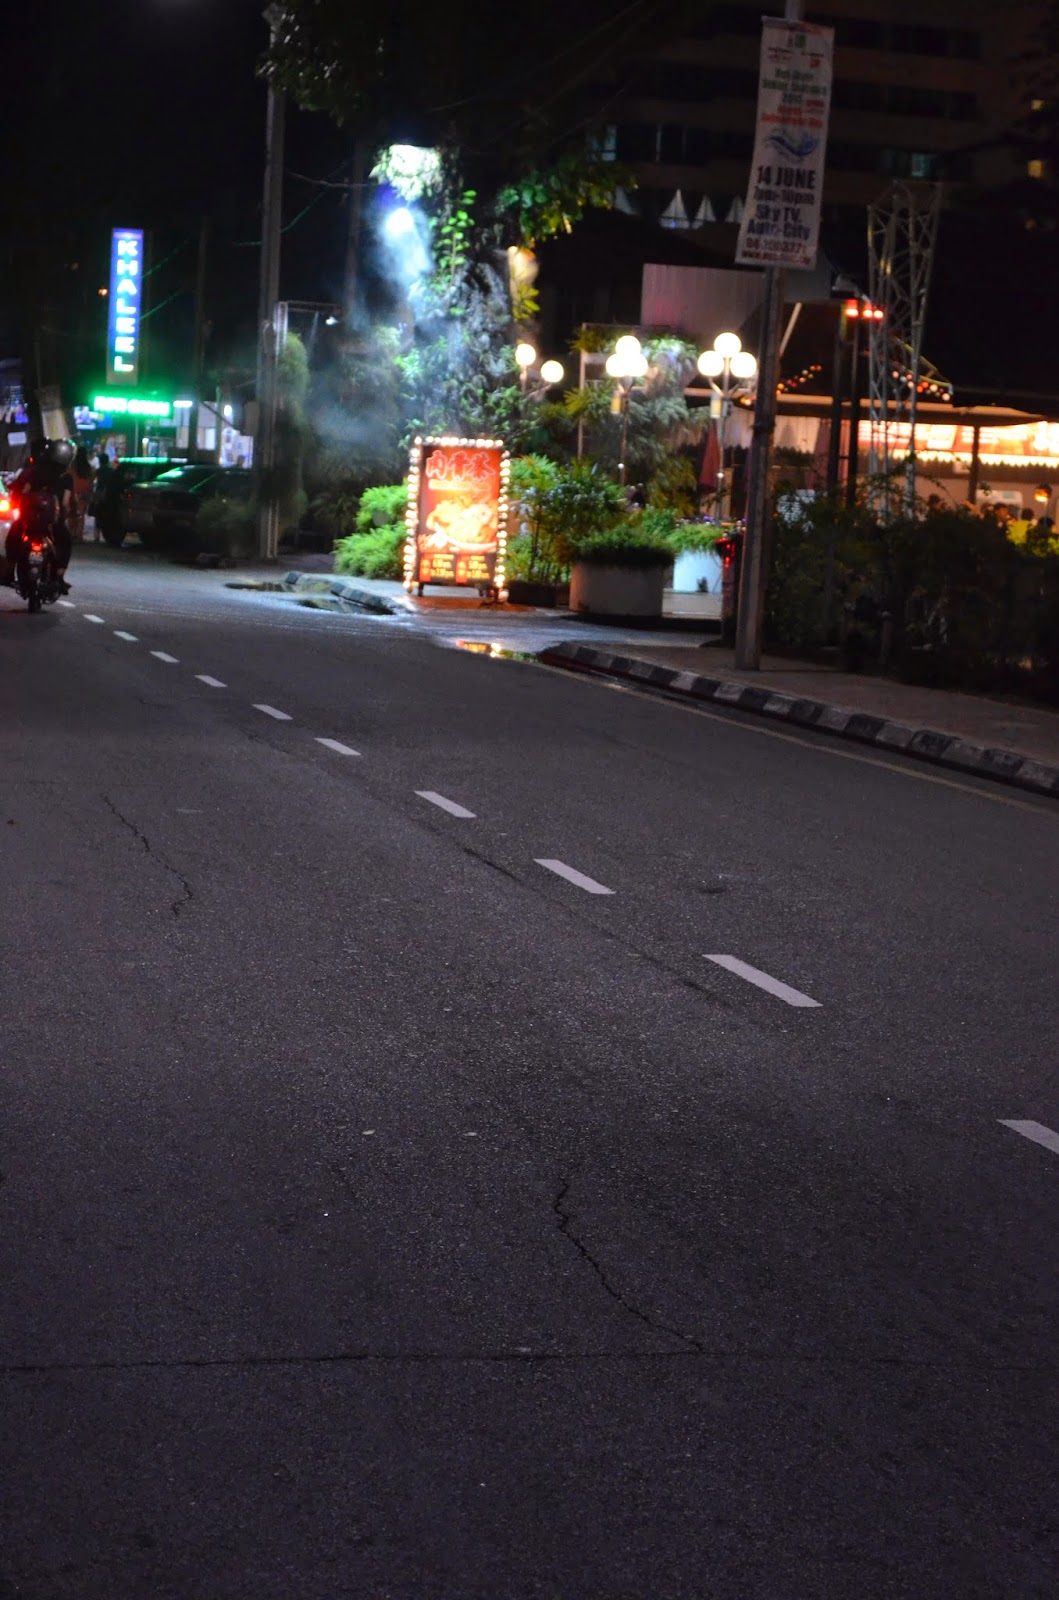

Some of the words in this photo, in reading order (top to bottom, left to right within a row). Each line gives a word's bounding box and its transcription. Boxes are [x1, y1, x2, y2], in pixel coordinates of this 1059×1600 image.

[758, 166, 772, 185] 14
[776, 167, 816, 189] JUNE
[114, 239, 138, 372] KHALEEL
